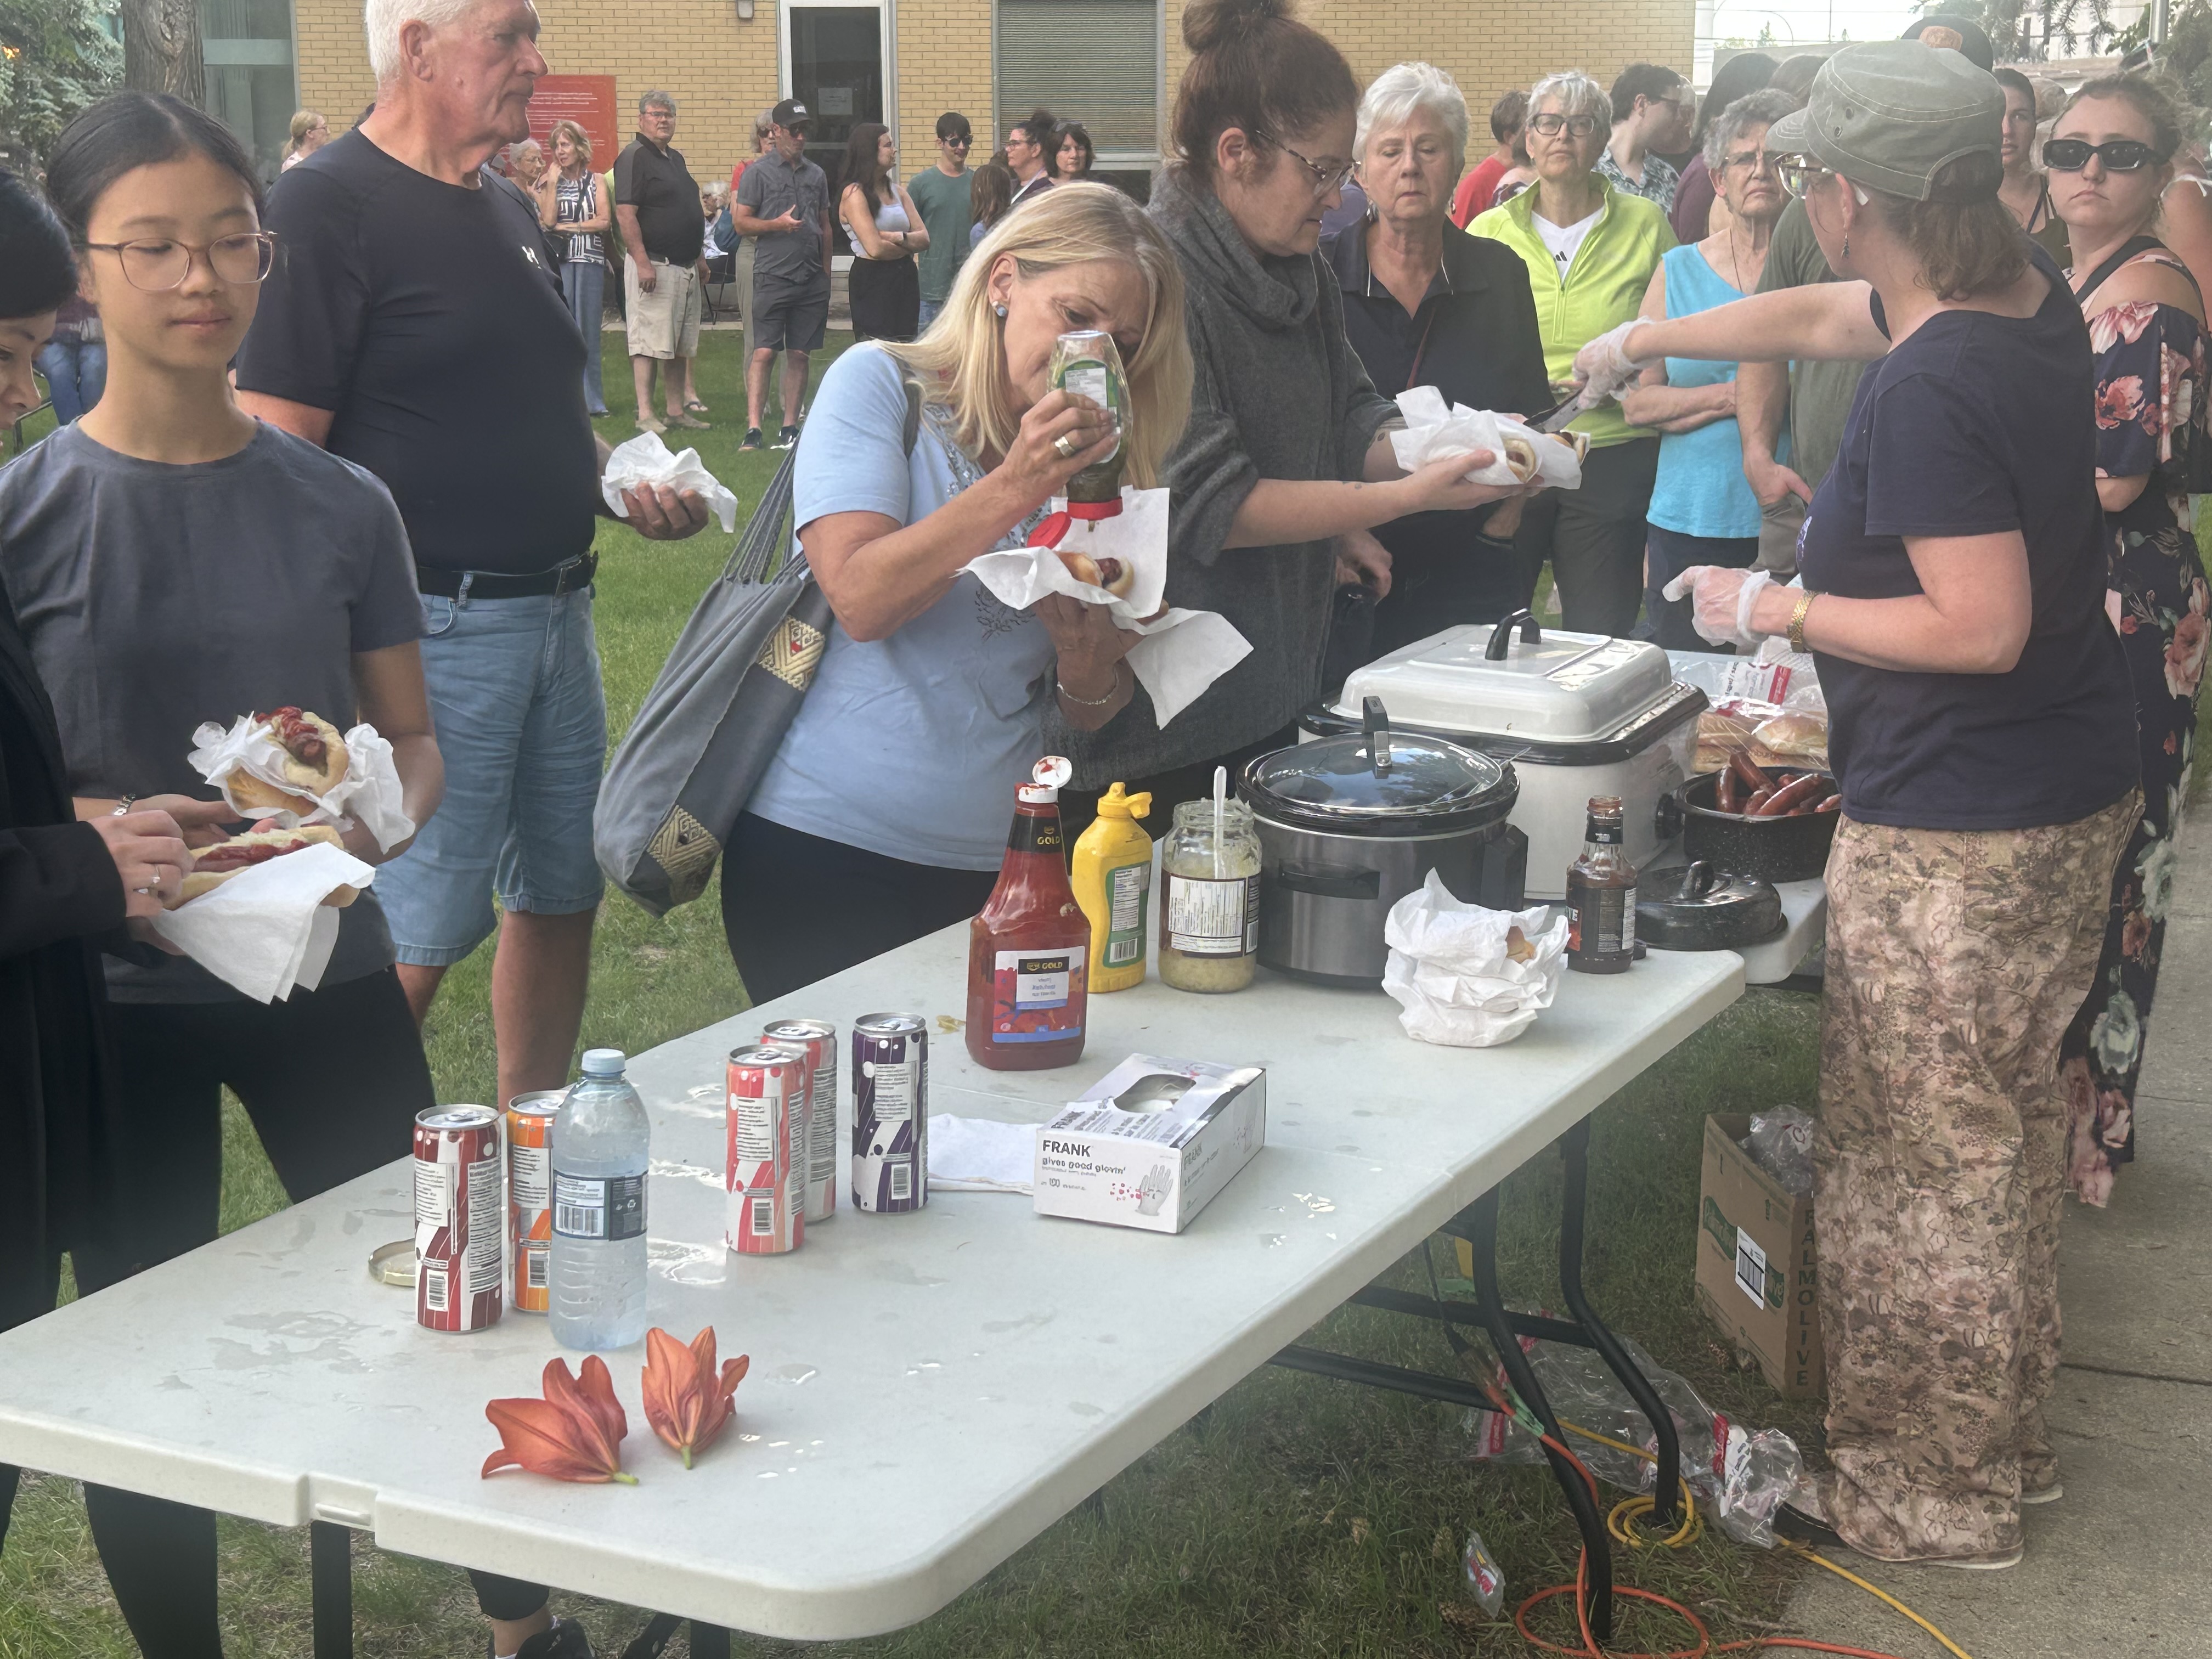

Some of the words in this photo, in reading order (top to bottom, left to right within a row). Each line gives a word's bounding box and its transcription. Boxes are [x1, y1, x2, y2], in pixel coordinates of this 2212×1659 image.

[1037, 836, 1060, 845] GOLD
[1043, 1139, 1091, 1157] FRANK
[1796, 1209, 1816, 1386] PALMOLIVE
